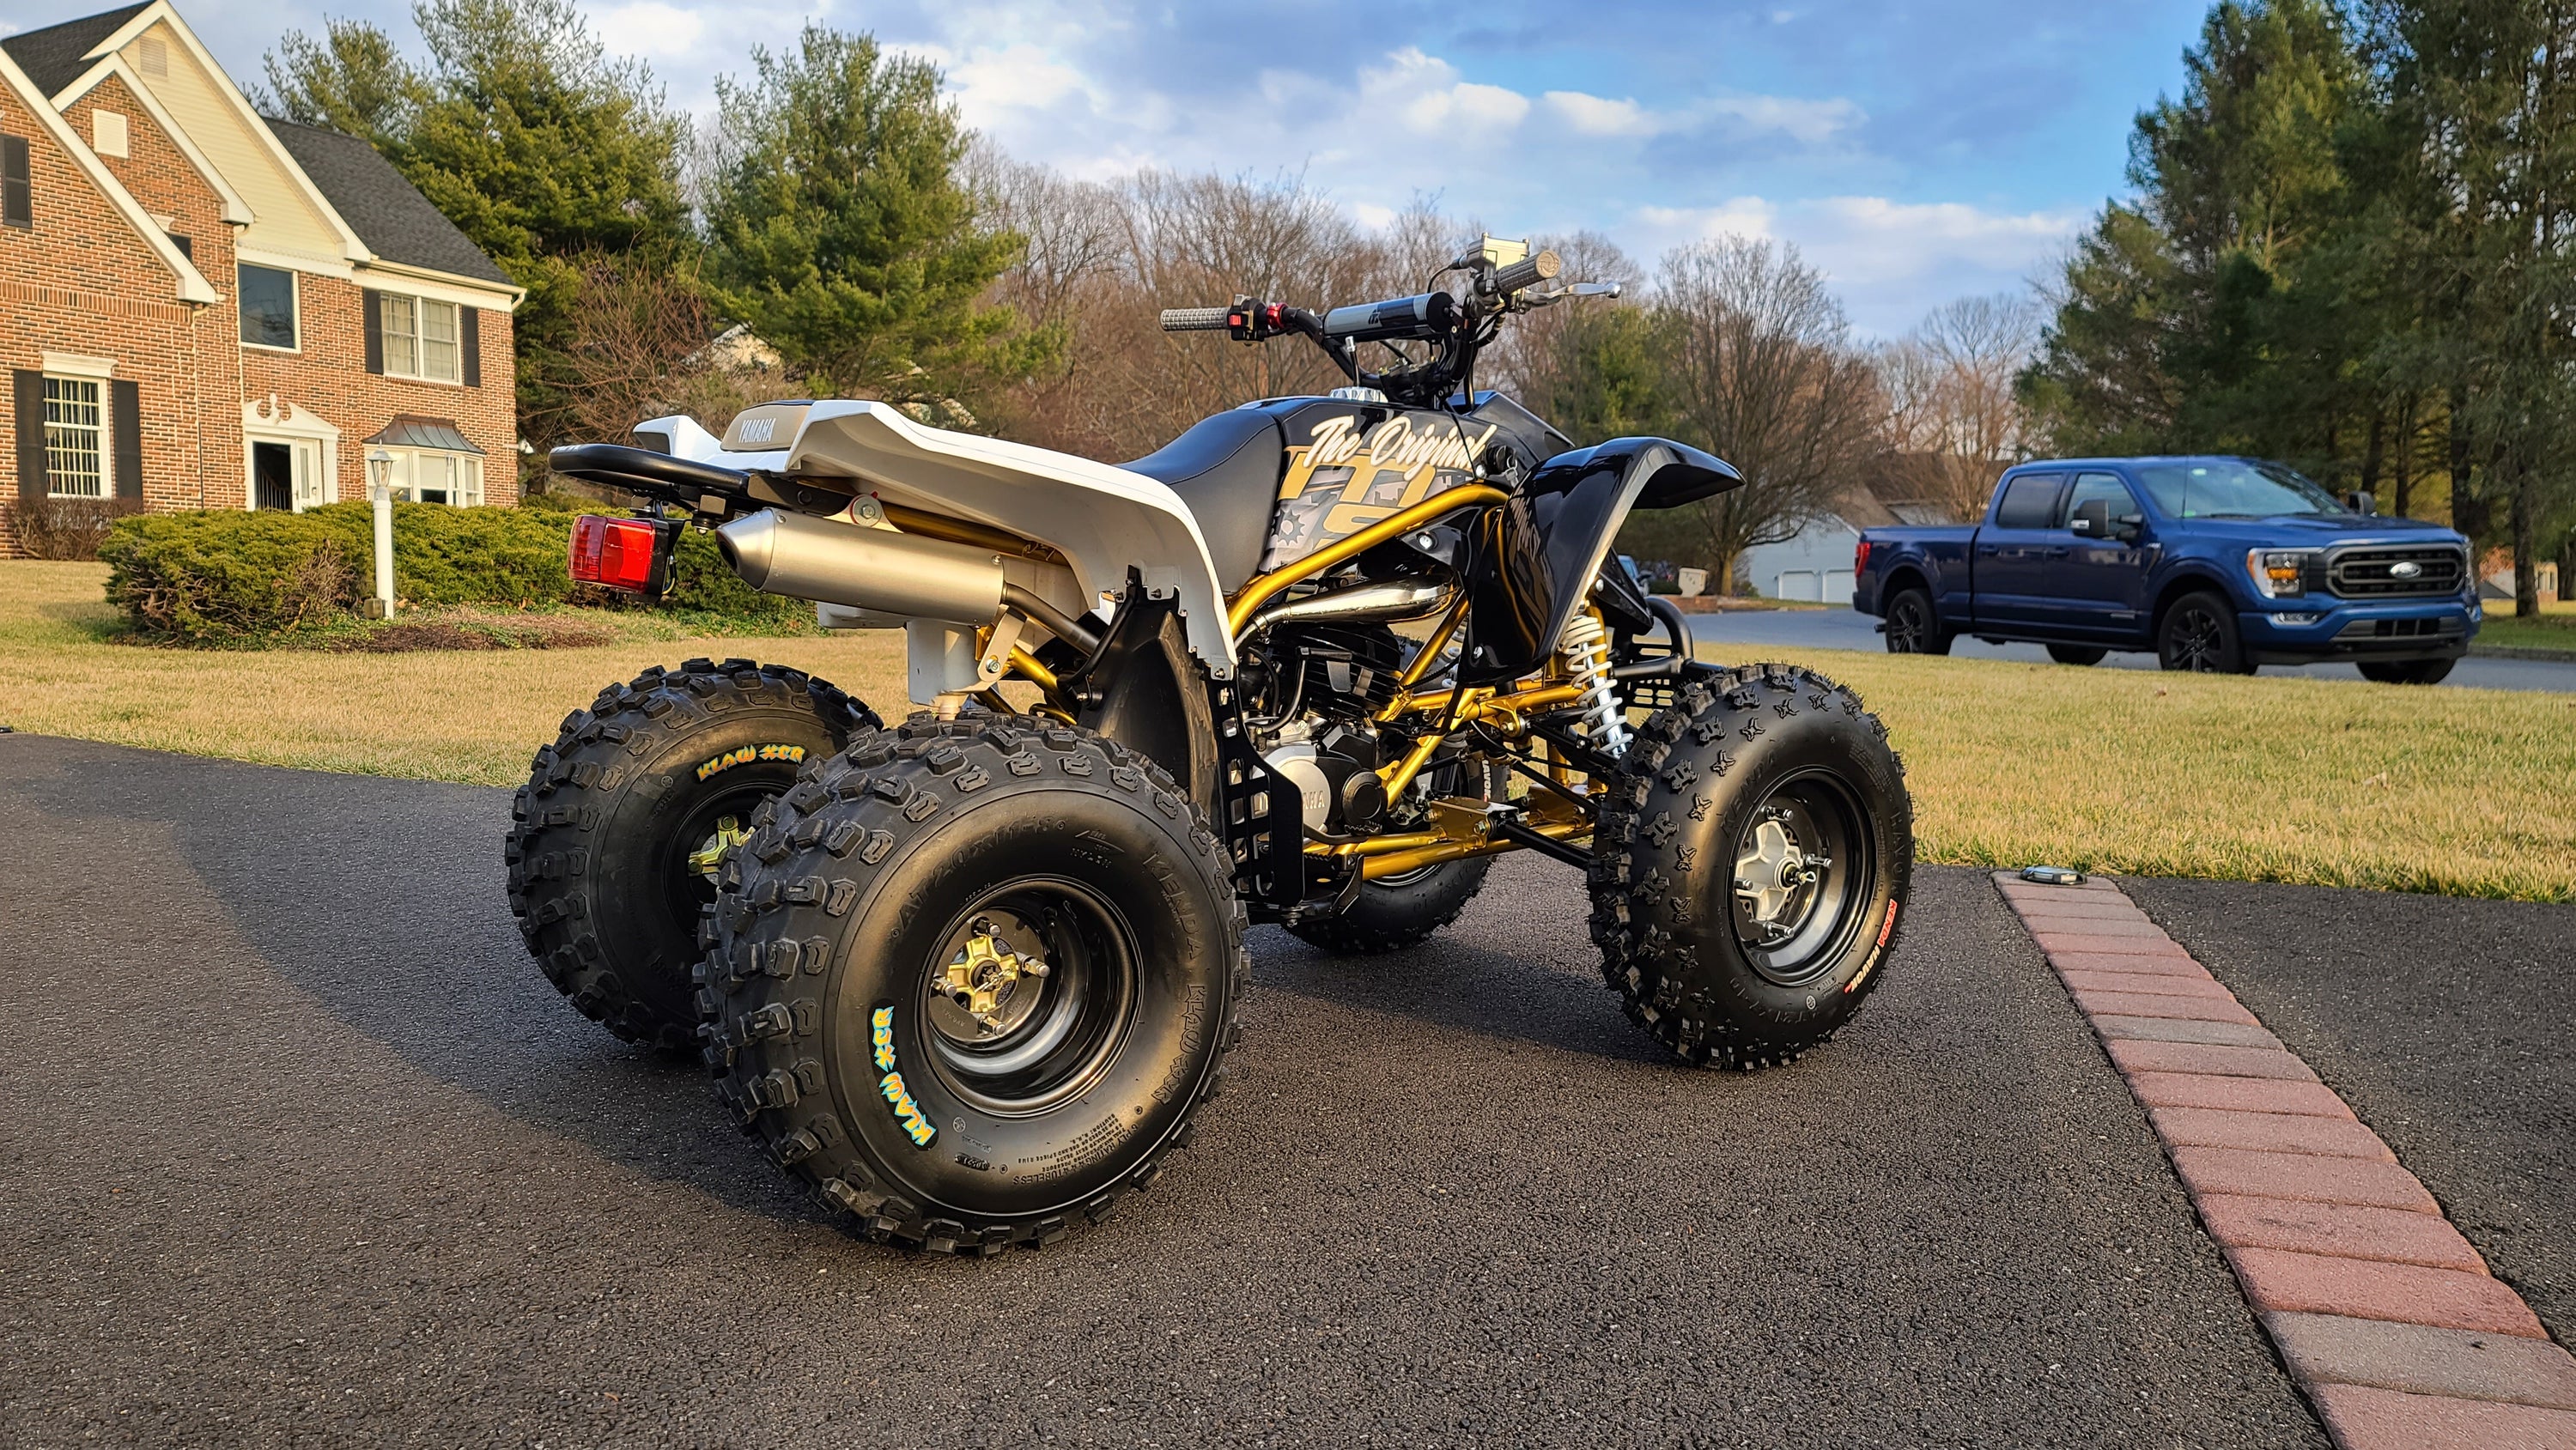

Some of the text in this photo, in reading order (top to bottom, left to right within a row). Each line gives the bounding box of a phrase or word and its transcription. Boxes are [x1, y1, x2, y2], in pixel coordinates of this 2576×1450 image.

[738, 417, 776, 444] YAMAHA
[1303, 415, 1498, 482] The Original
[696, 744, 805, 782] KLAW XCR
[1143, 851, 1202, 960] KENDA
[1877, 898, 1898, 948] KENDA
[1851, 944, 1880, 992] HAVOK
[1179, 985, 1206, 1053] KLAW
[872, 1005, 937, 1146] KLAW XCR
[1013, 1124, 1139, 1185] 6 PLY RATING TUBELESS
